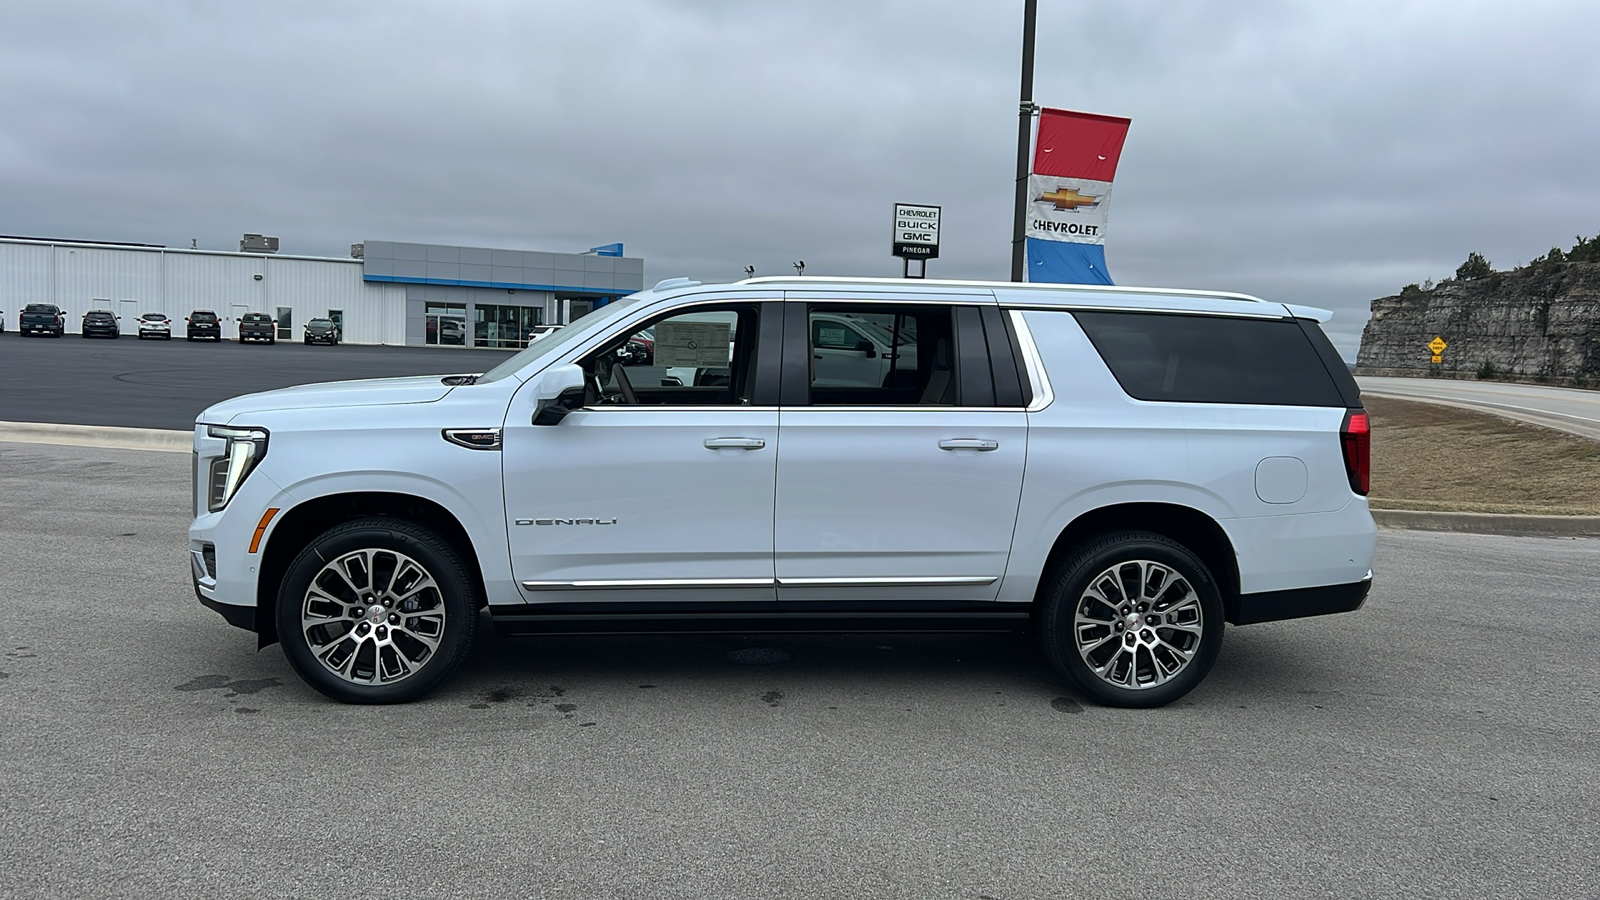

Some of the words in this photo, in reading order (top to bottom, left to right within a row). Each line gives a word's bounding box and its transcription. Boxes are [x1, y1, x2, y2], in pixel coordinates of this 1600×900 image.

[899, 209, 937, 218] CHEVROLET
[898, 221, 937, 230] BUICK
[1033, 220, 1098, 236] CHEVROLET
[903, 232, 931, 241] GMC
[902, 246, 931, 254] PINEGAR
[515, 517, 617, 526] DENALI
